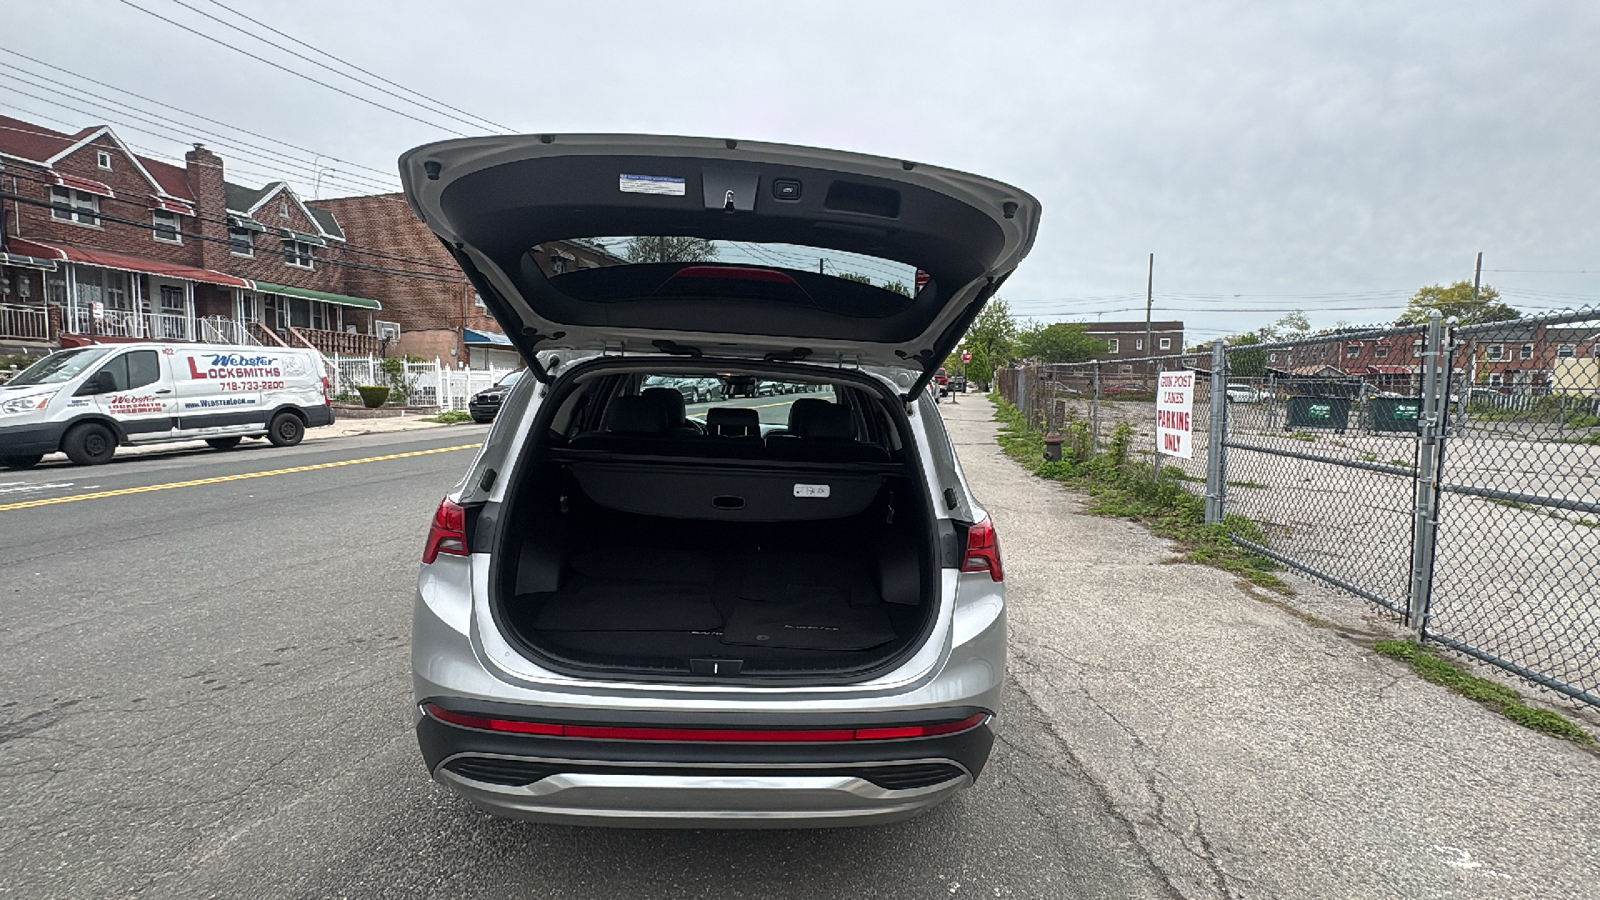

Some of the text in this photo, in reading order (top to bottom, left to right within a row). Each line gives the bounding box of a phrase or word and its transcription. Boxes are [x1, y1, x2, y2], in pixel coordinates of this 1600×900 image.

[201, 353, 278, 367] Webster
[187, 356, 281, 379] LOCKSMITHS
[219, 380, 285, 391] 718-733-2200
[1174, 375, 1193, 387] POST
[1164, 391, 1184, 404] LANES
[1158, 409, 1190, 432] PARKING
[1164, 433, 1181, 453] ONLY
